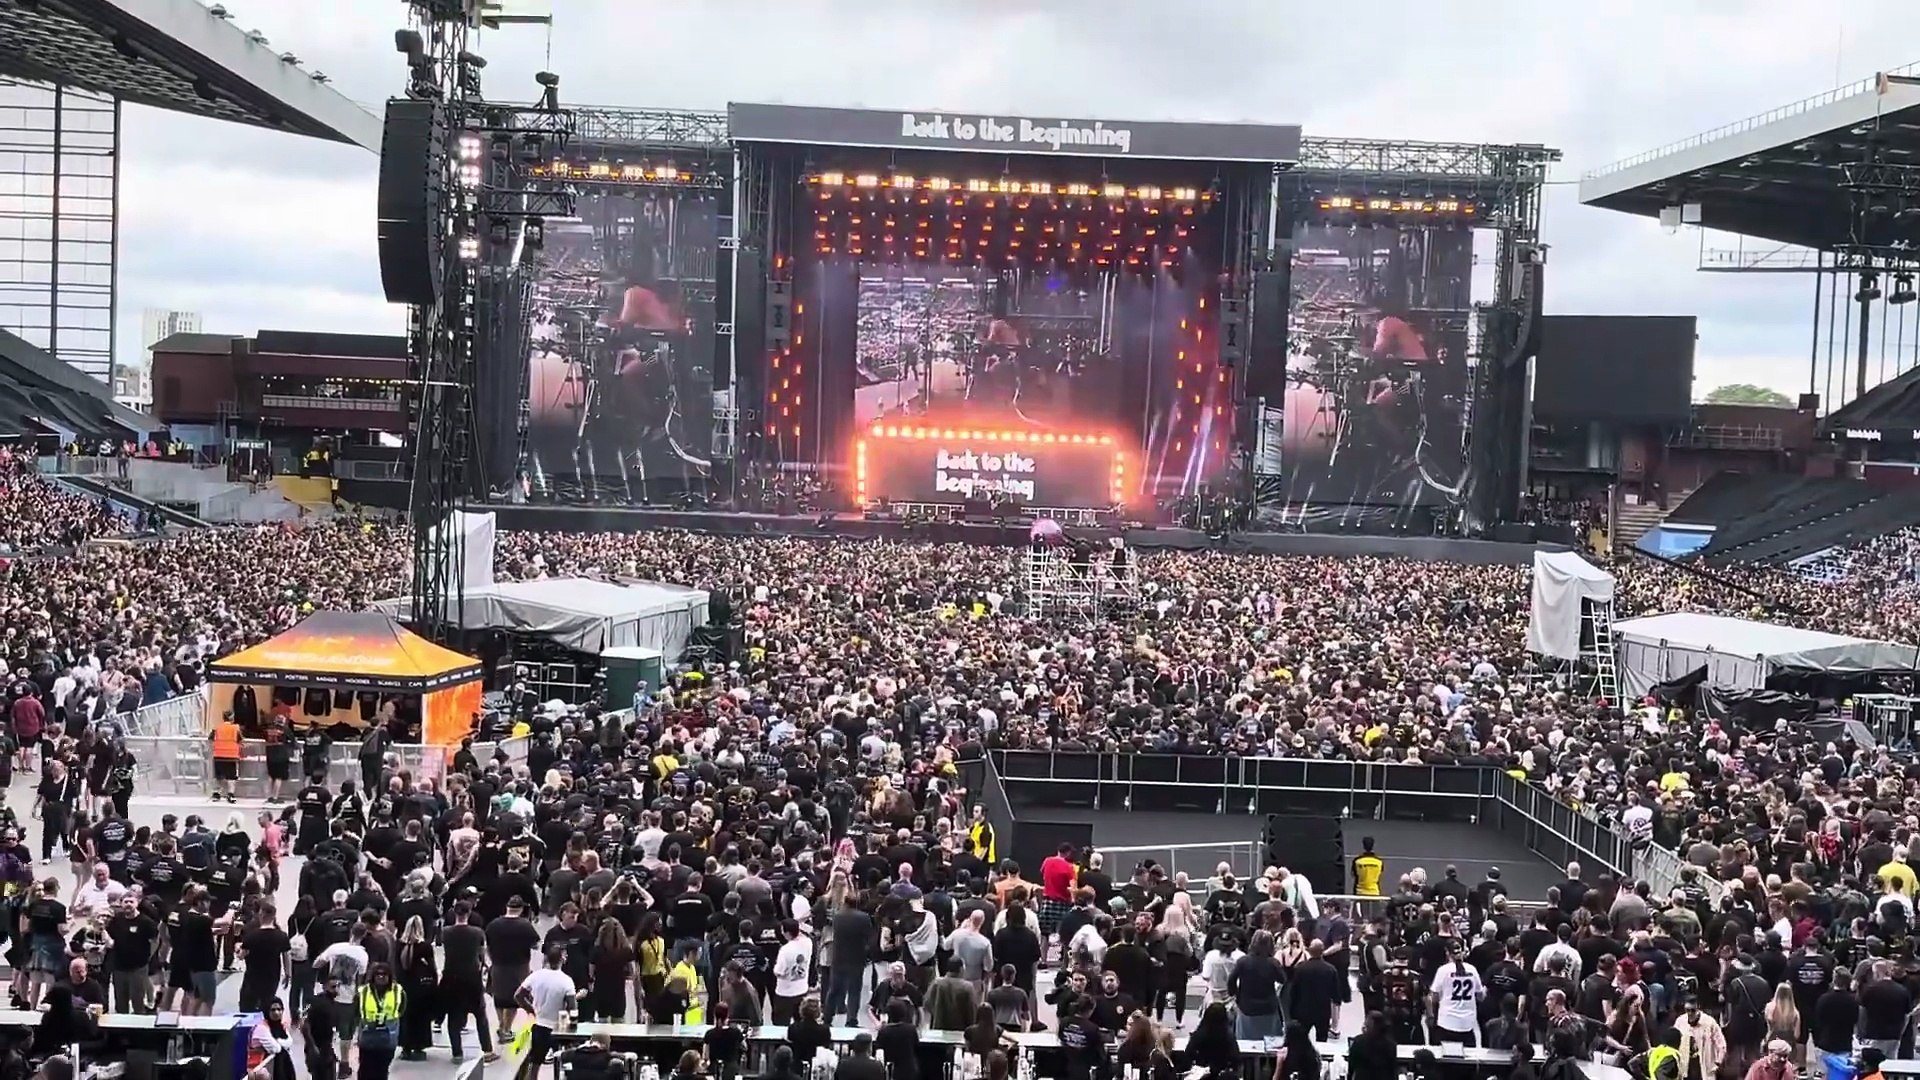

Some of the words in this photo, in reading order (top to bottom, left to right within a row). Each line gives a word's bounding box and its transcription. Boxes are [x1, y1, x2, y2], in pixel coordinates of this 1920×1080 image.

[902, 114, 949, 138] Back
[953, 118, 977, 140] to
[979, 118, 1015, 142] the
[1019, 119, 1131, 152] Beginning
[936, 449, 979, 471] Back
[981, 452, 1001, 472] to
[1003, 452, 1036, 472] the
[1451, 979, 1473, 1001] 22
